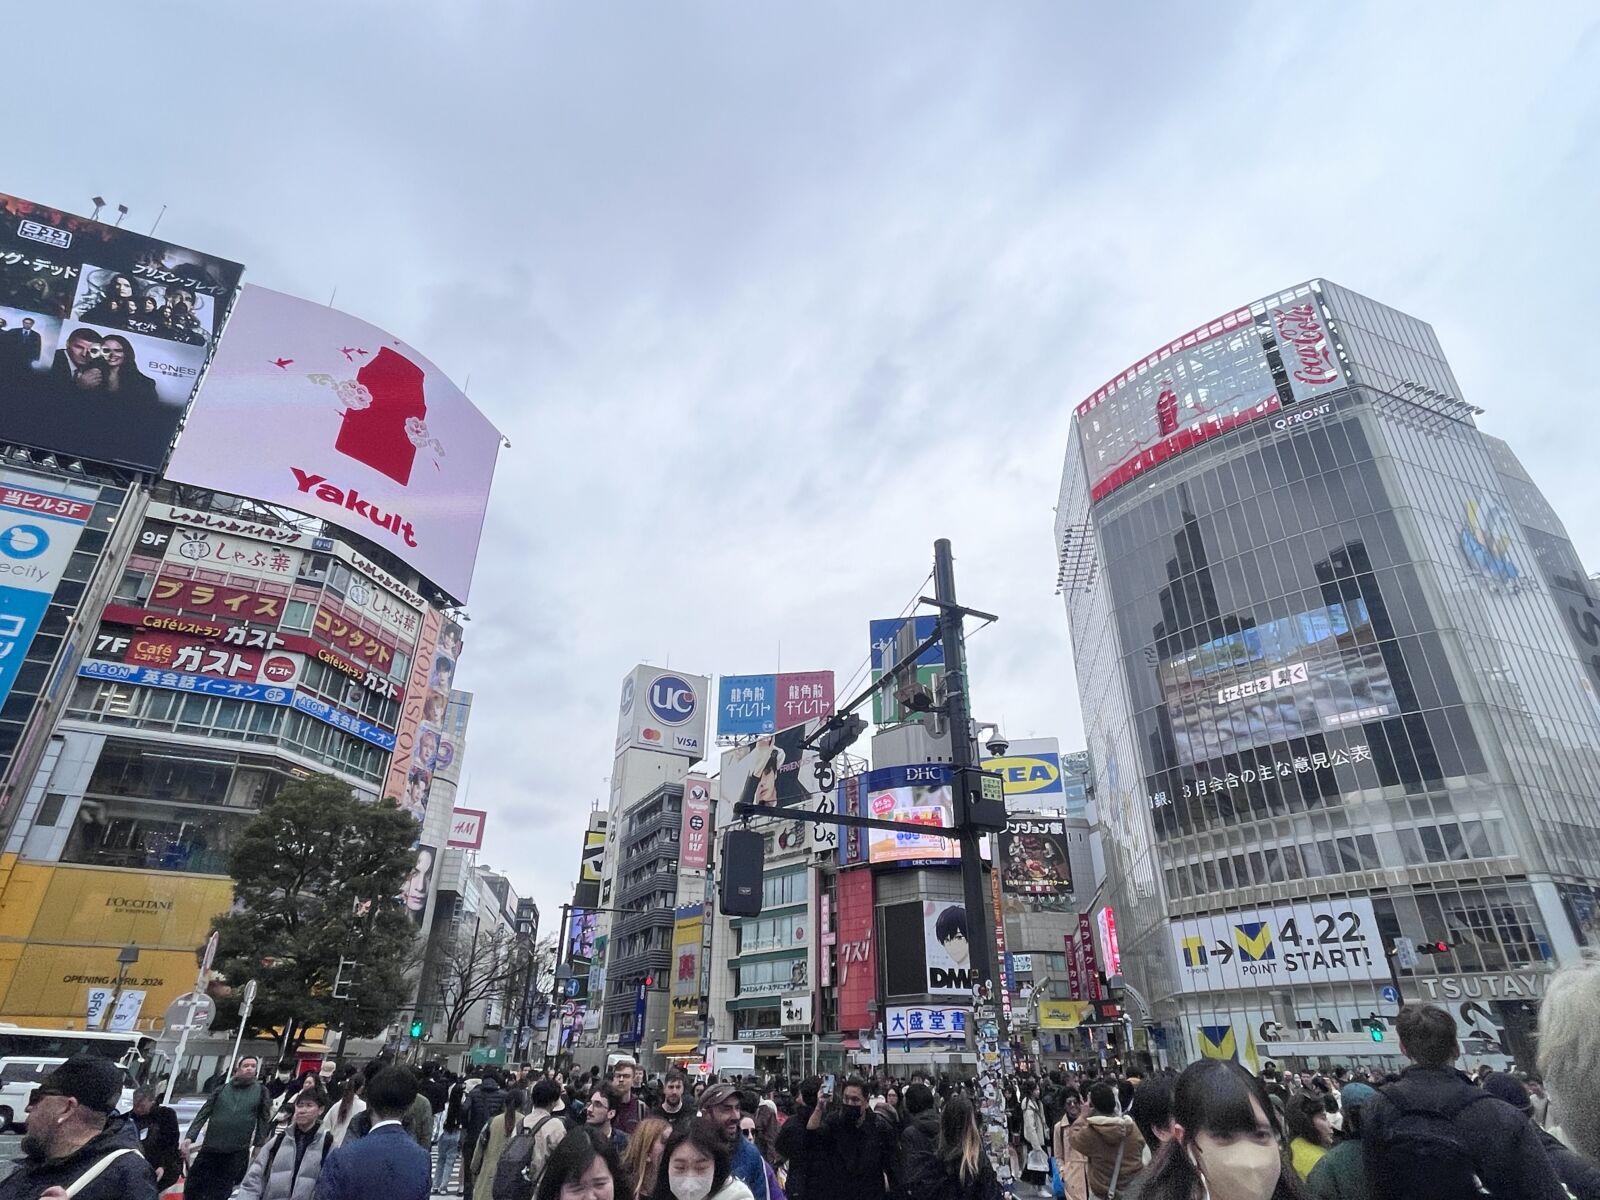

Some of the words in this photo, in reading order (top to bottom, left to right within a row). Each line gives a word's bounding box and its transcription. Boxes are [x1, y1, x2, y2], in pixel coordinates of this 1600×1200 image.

[148, 361, 197, 376] BONES
[1275, 403, 1330, 430] QFRONT
[3, 491, 82, 515] 当ビル5F
[290, 467, 418, 548] Yakult
[141, 531, 168, 547] 9F
[215, 542, 291, 572] しゃぶ葉
[155, 581, 279, 618] プライス
[371, 592, 418, 632] しゃぶ葉
[96, 635, 131, 653] 7F
[136, 641, 173, 658] Café
[223, 626, 285, 650] ガスト
[315, 608, 390, 664] コンタクト
[172, 645, 252, 677] ガスト
[87, 662, 132, 678] AEON
[141, 668, 260, 697] 英会話イーオン
[267, 689, 284, 700] 6F
[363, 671, 399, 699] ガスト
[653, 684, 693, 713] UC
[327, 708, 397, 748] 英会話イーオン
[676, 736, 698, 748] VISA
[906, 767, 941, 781] DHC
[1182, 745, 1372, 798] 3月会合の主な意見公表
[454, 821, 475, 836] H&M
[106, 897, 174, 909] L'OCCITANE
[1081, 920, 1093, 964] カラオケ
[1278, 911, 1366, 947] 4.22
[1242, 963, 1277, 975] POINT
[1283, 947, 1373, 972] START!
[63, 975, 110, 985] OPENING
